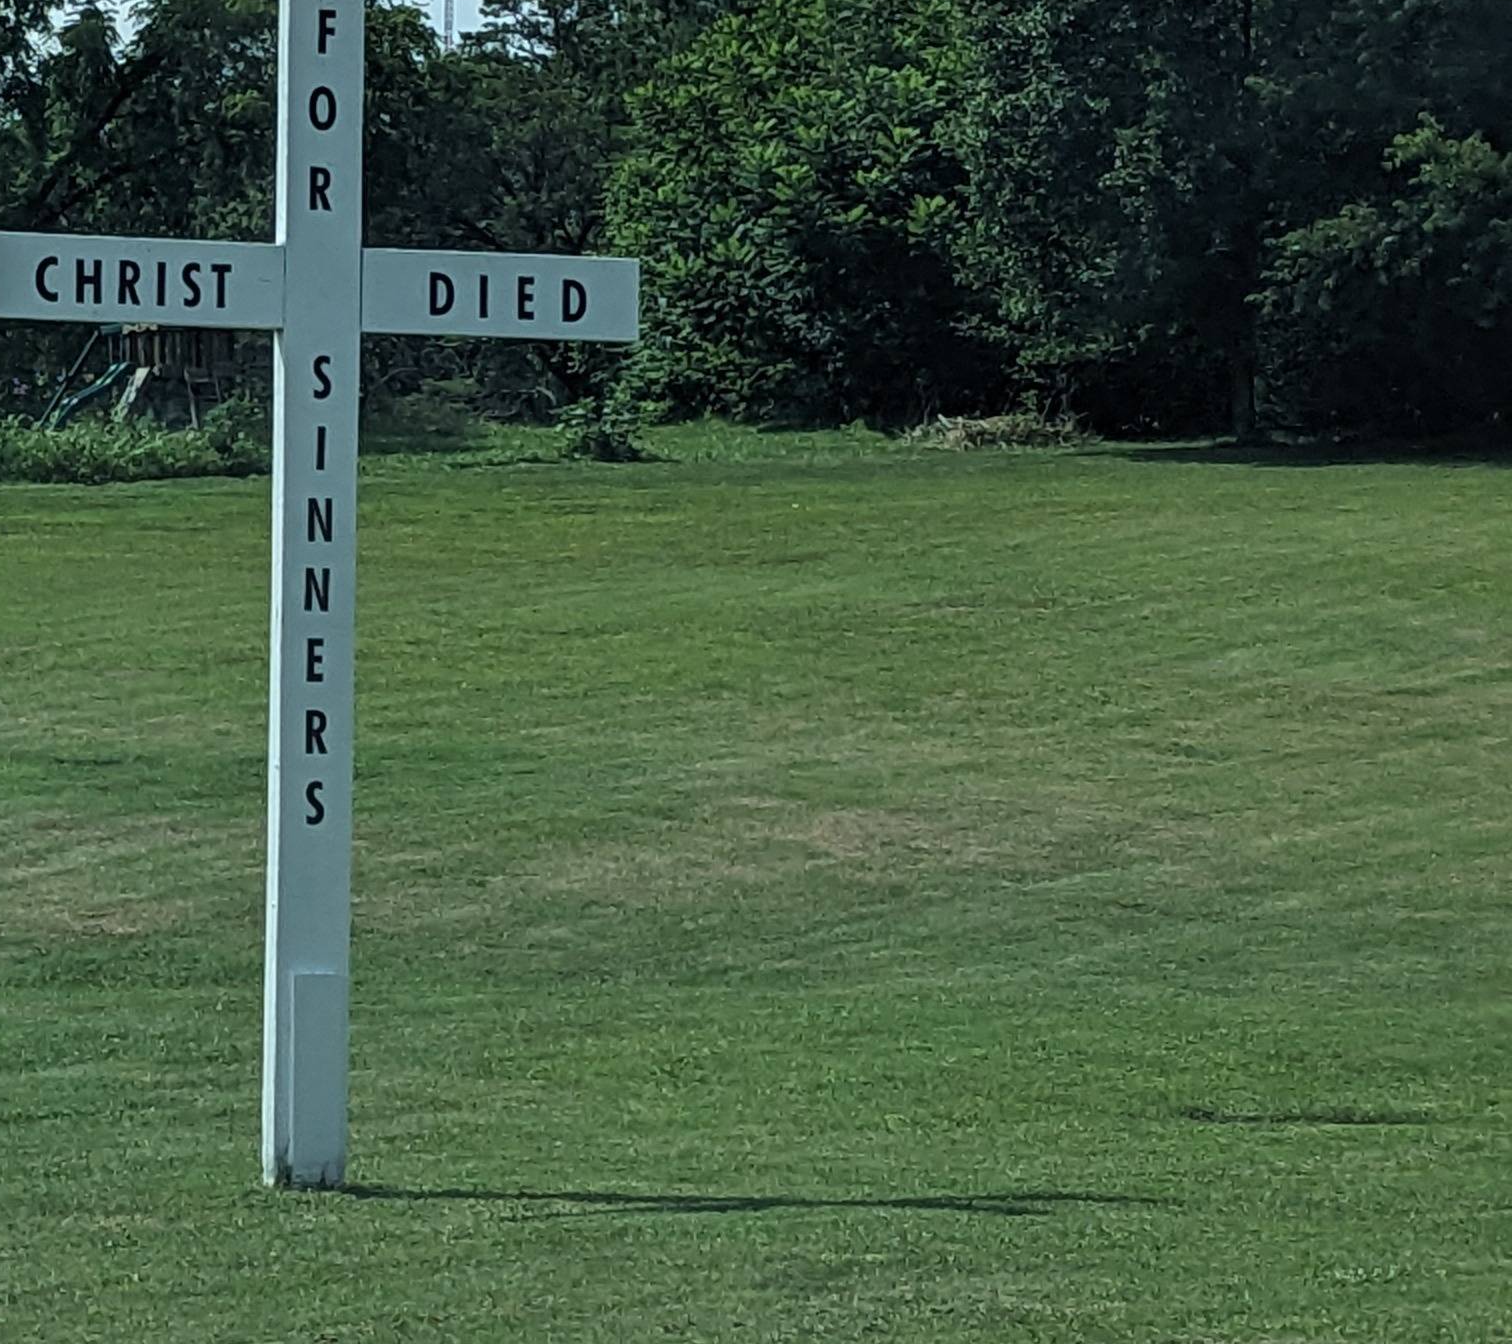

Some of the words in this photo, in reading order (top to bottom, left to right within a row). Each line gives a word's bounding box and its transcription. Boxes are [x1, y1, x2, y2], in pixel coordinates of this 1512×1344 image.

[307, 8, 338, 213] FOR
[34, 255, 233, 310] CHRIST
[428, 270, 588, 324] DIED
[303, 354, 334, 827] SINNERS
